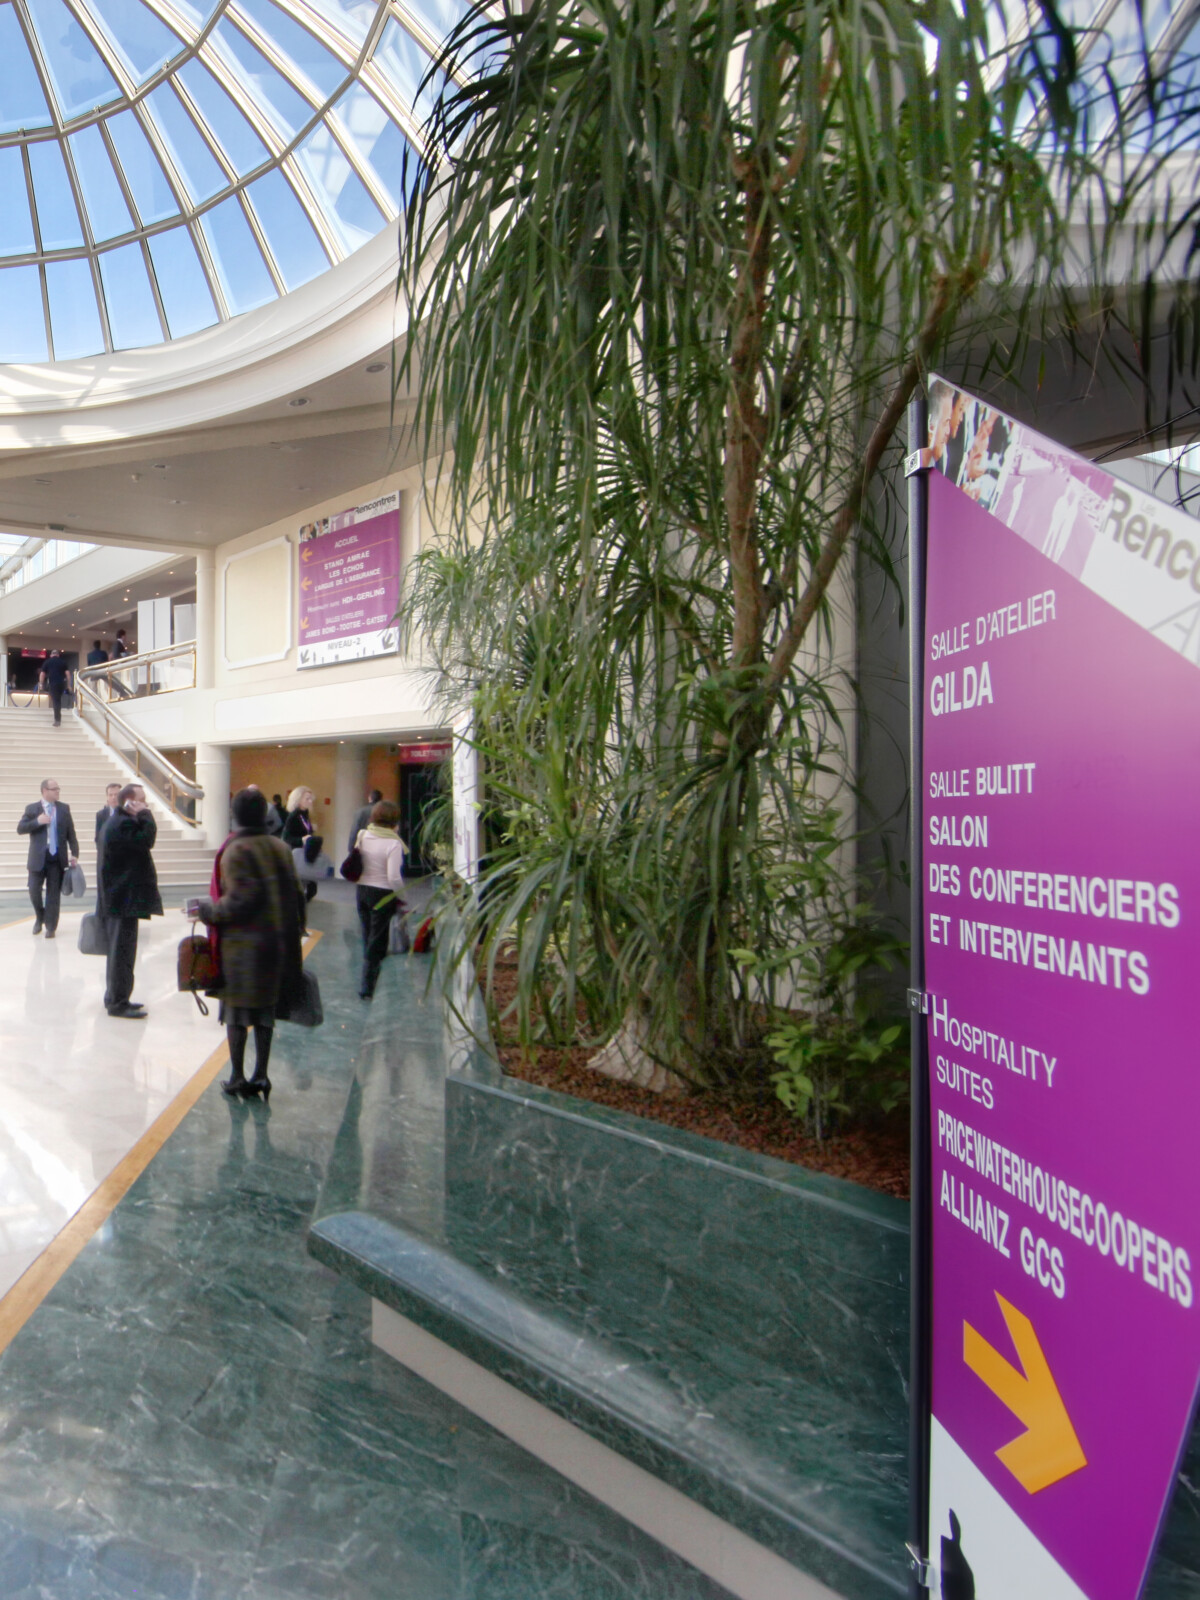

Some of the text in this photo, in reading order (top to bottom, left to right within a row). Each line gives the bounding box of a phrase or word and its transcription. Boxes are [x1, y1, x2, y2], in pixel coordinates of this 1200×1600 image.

[324, 550, 370, 570] STAND AMRAE
[334, 535, 359, 549] ACCUEIL
[328, 562, 364, 578] LES ECHOS
[931, 589, 1056, 661] SALLE D'ATELIER
[930, 661, 993, 717] GILDA
[929, 762, 1036, 798] SALLE BULITT
[929, 815, 988, 848] SALON
[929, 863, 1180, 928] DES CONFERENCIERS
[930, 913, 1150, 995] ET INTERVENANTS
[936, 1055, 994, 1110] SUITES
[938, 1108, 1193, 1309] PRICEWATERHOUSECOOPERS
[940, 1169, 1065, 1299] ALLIANZ GCS
